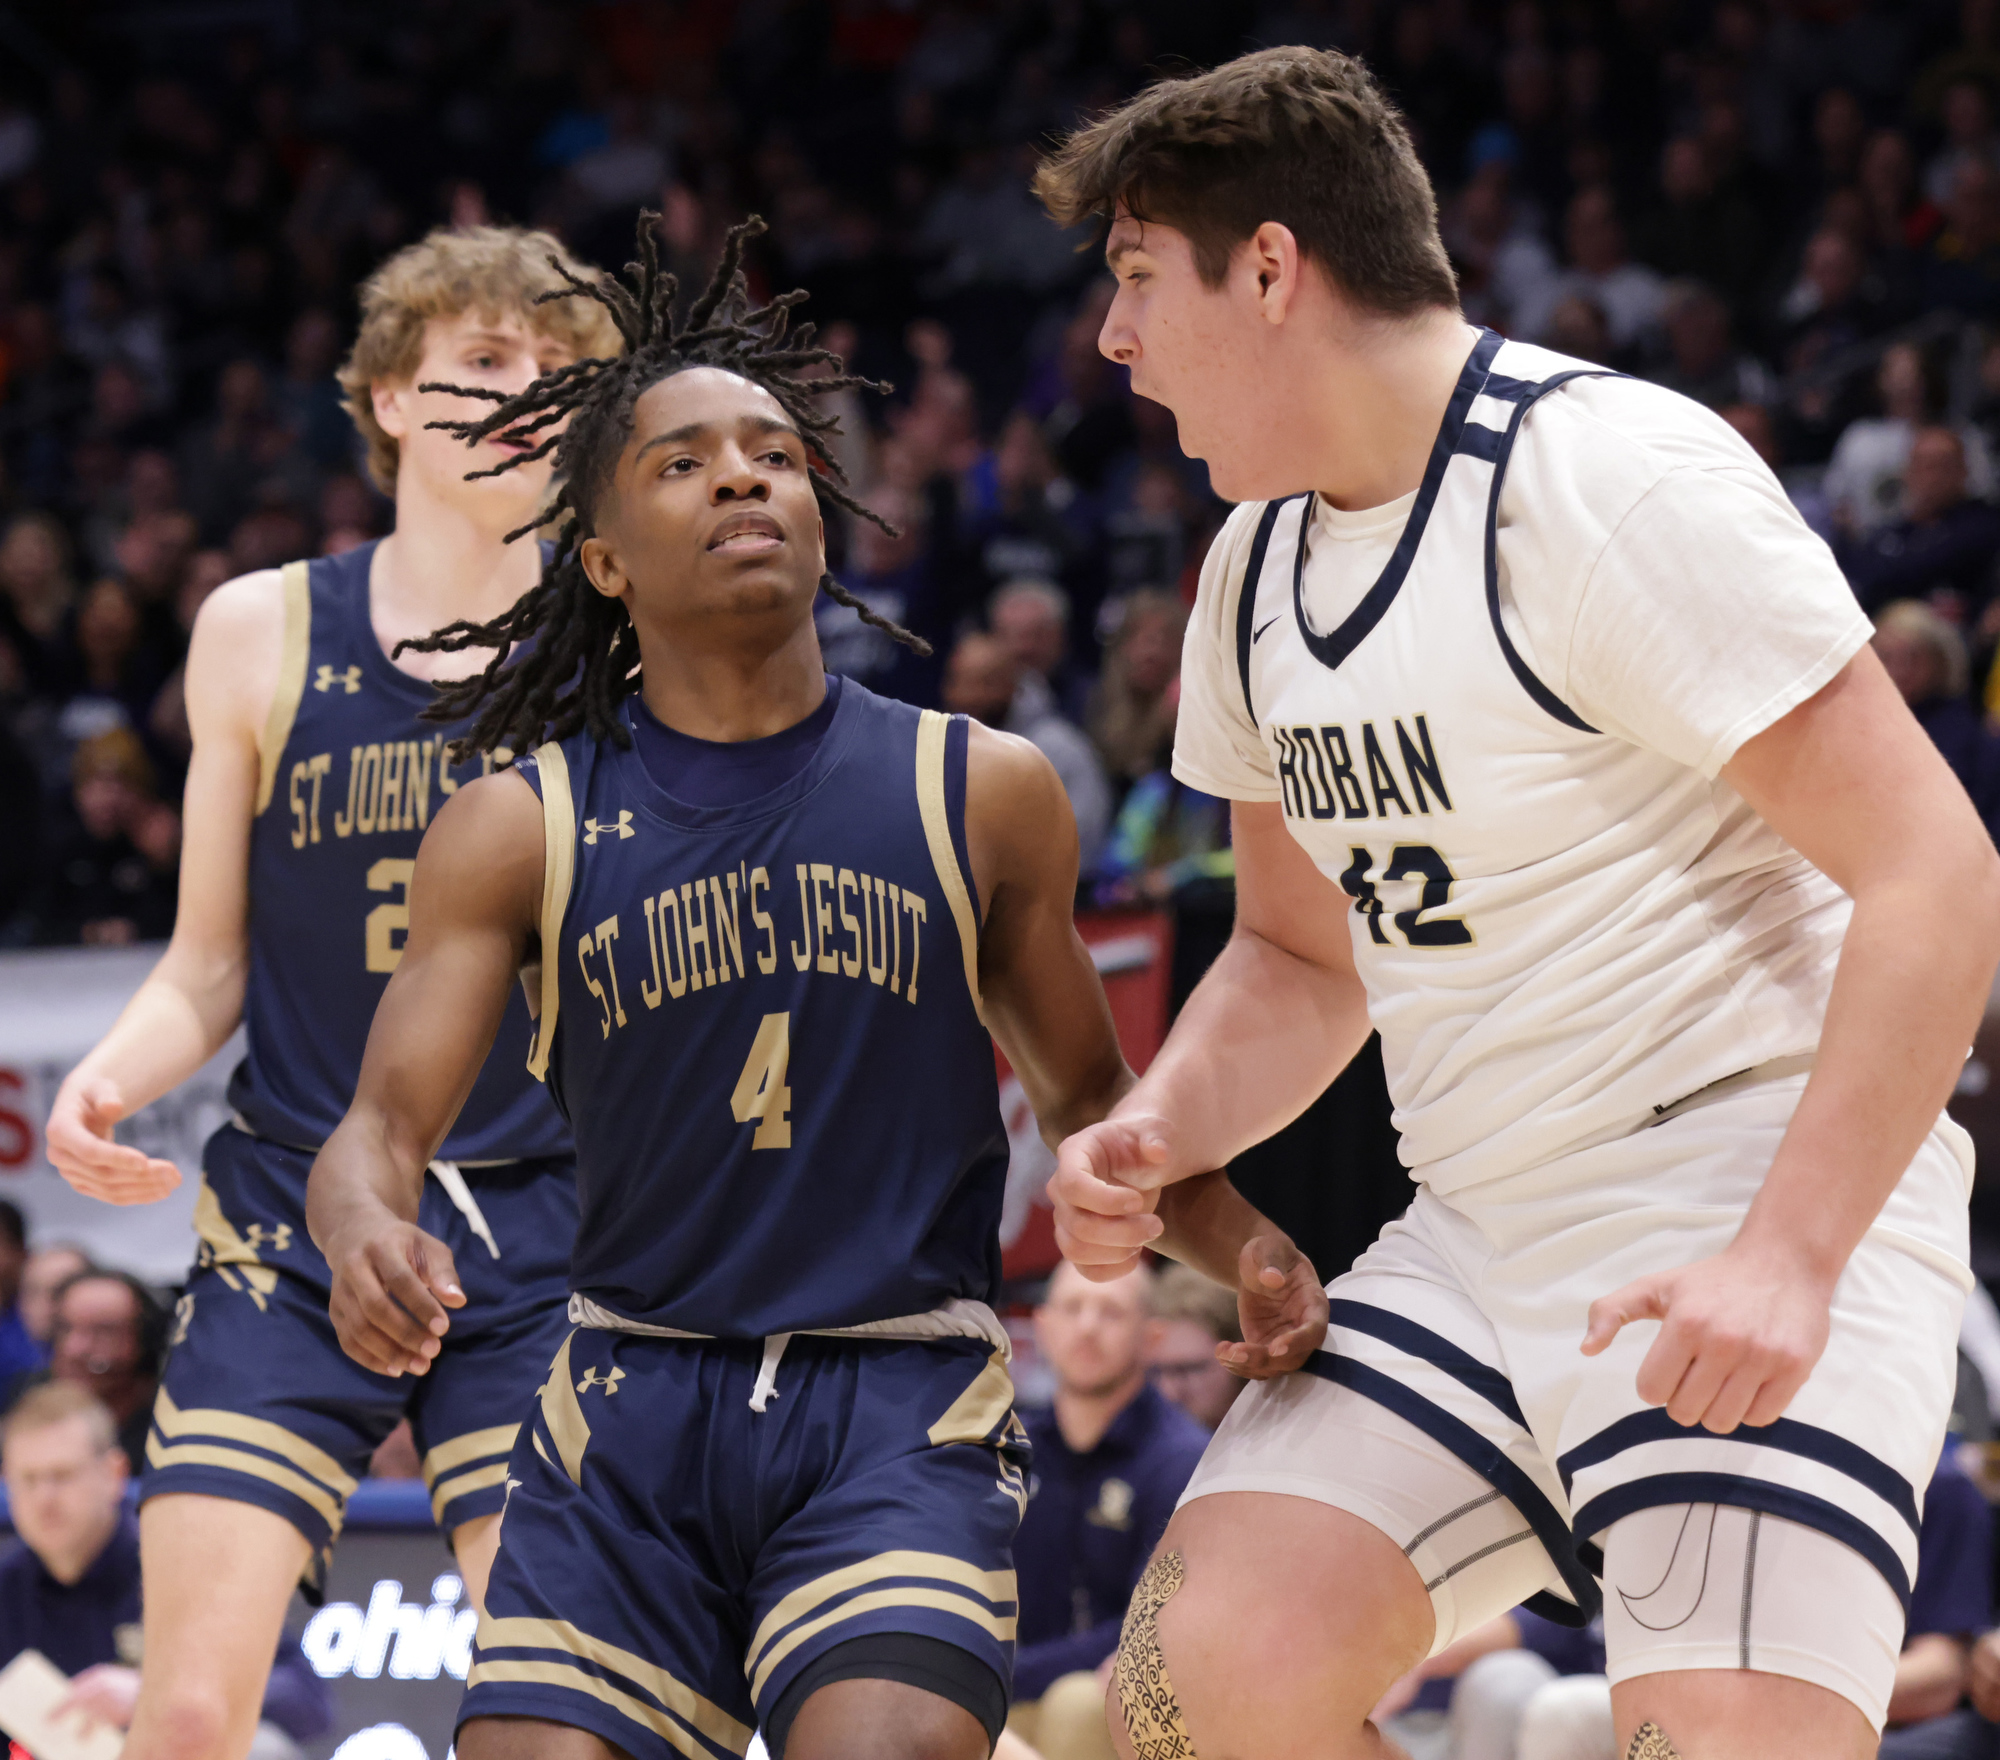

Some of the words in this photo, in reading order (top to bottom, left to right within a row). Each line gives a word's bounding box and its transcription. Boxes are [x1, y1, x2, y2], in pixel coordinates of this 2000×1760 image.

[289, 751, 333, 850] ST
[1271, 711, 1457, 823] HOBAN
[578, 914, 628, 1041] ST
[640, 859, 777, 1011] JOHN'S
[790, 862, 928, 1006] JESUIT
[729, 1010, 792, 1152] 4
